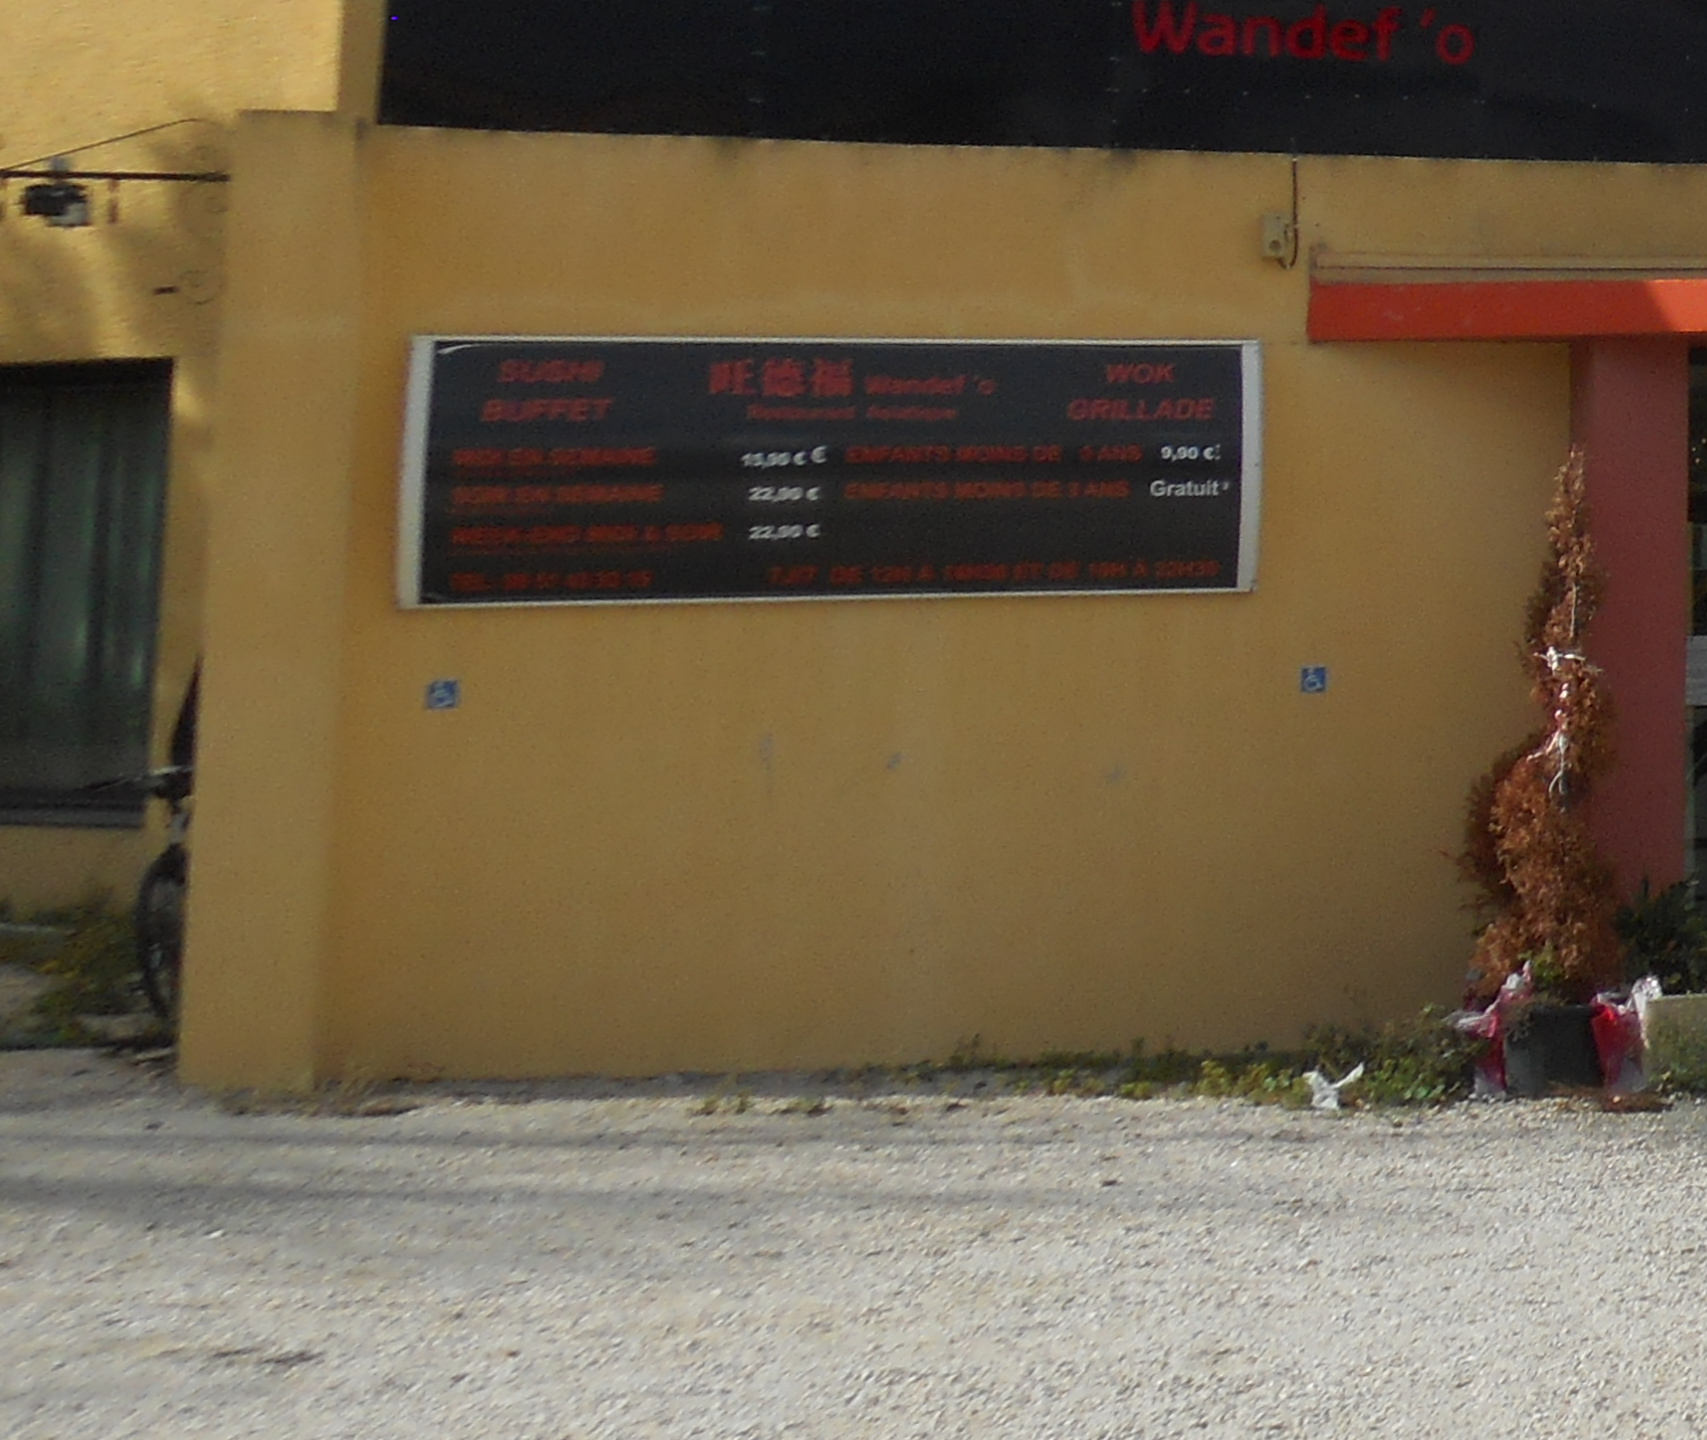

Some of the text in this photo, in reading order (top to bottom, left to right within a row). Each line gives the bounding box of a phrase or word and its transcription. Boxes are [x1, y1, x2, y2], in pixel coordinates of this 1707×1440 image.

[497, 359, 606, 384] SUSHI
[1105, 362, 1176, 385] WOK
[479, 397, 615, 423] BUFFET
[1067, 397, 1215, 421] GRILLADE
[1149, 478, 1221, 499] Gratuit
